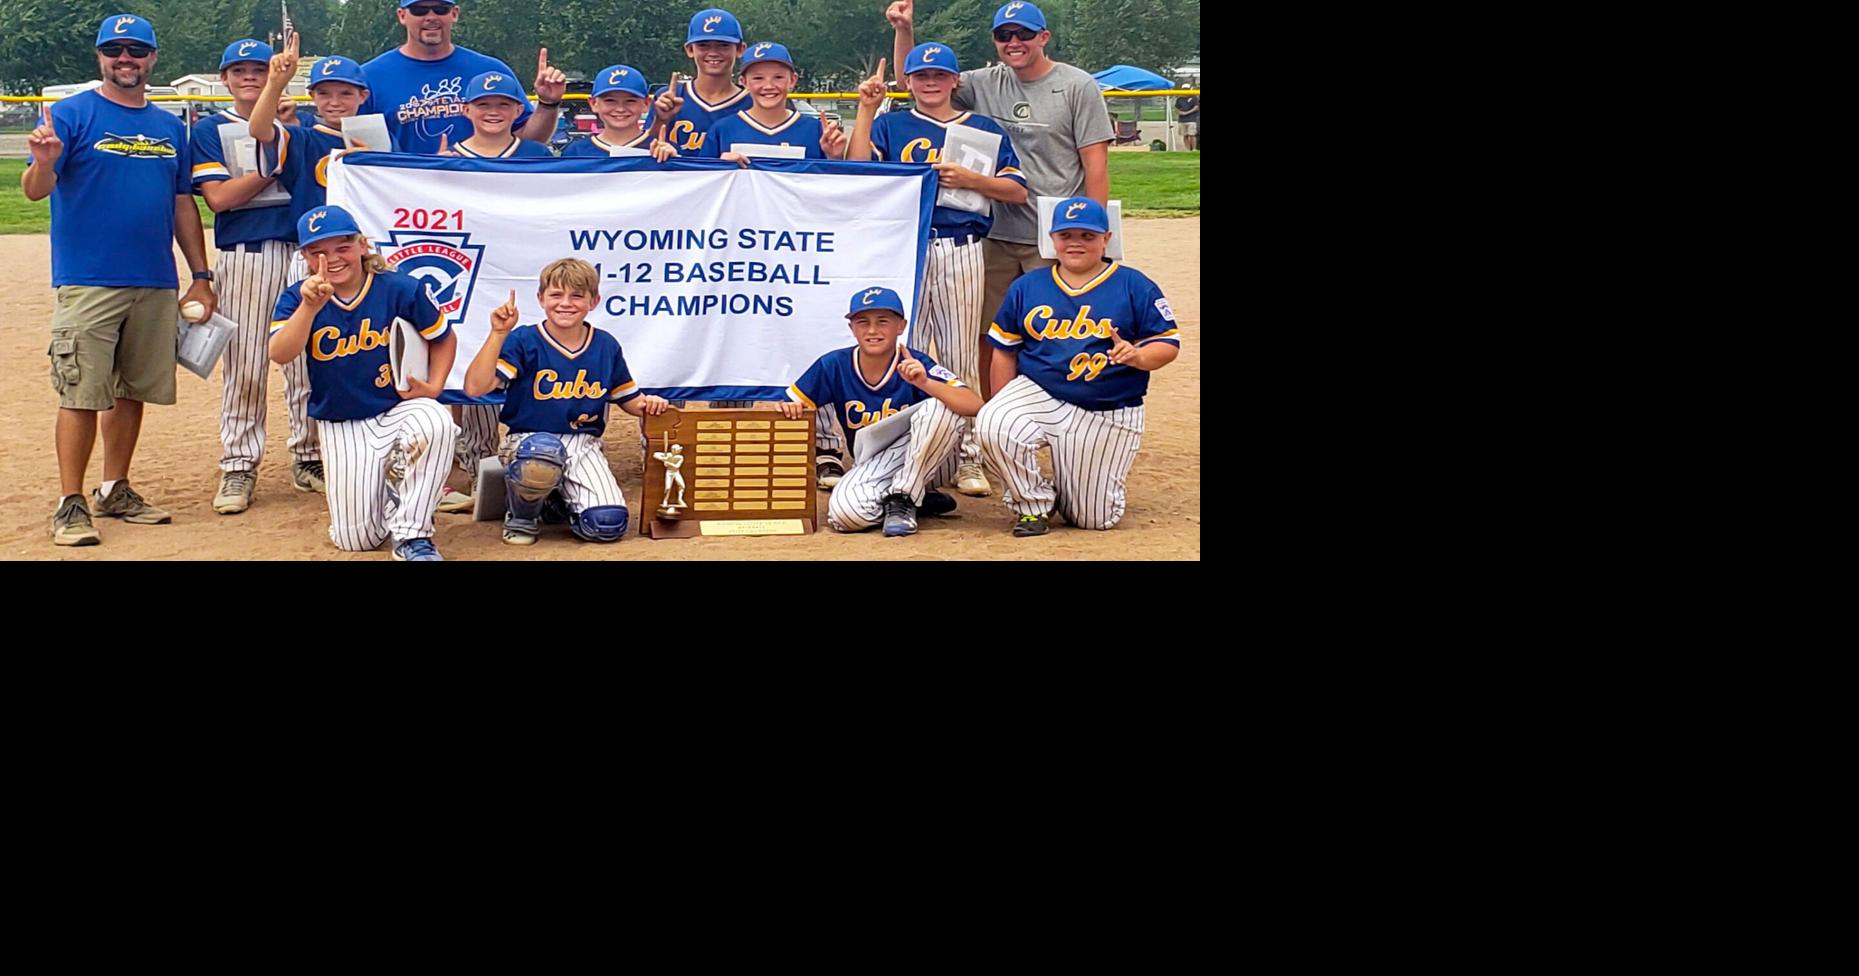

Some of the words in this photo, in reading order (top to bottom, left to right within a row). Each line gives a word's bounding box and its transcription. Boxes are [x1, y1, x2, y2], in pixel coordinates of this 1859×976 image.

[393, 207, 464, 231] 2021
[569, 229, 729, 251] WYOMING
[737, 228, 835, 252] STATE
[388, 245, 424, 264] LITTLE
[428, 245, 470, 267] LEAGUE
[594, 262, 652, 283] 1-12
[664, 261, 831, 285] BASEBALL
[605, 293, 794, 317] CHAMPIONS
[1023, 305, 1119, 341] Cubs
[1066, 352, 1108, 382] 99
[533, 369, 608, 400] Cubs
[845, 398, 909, 429] Cub
